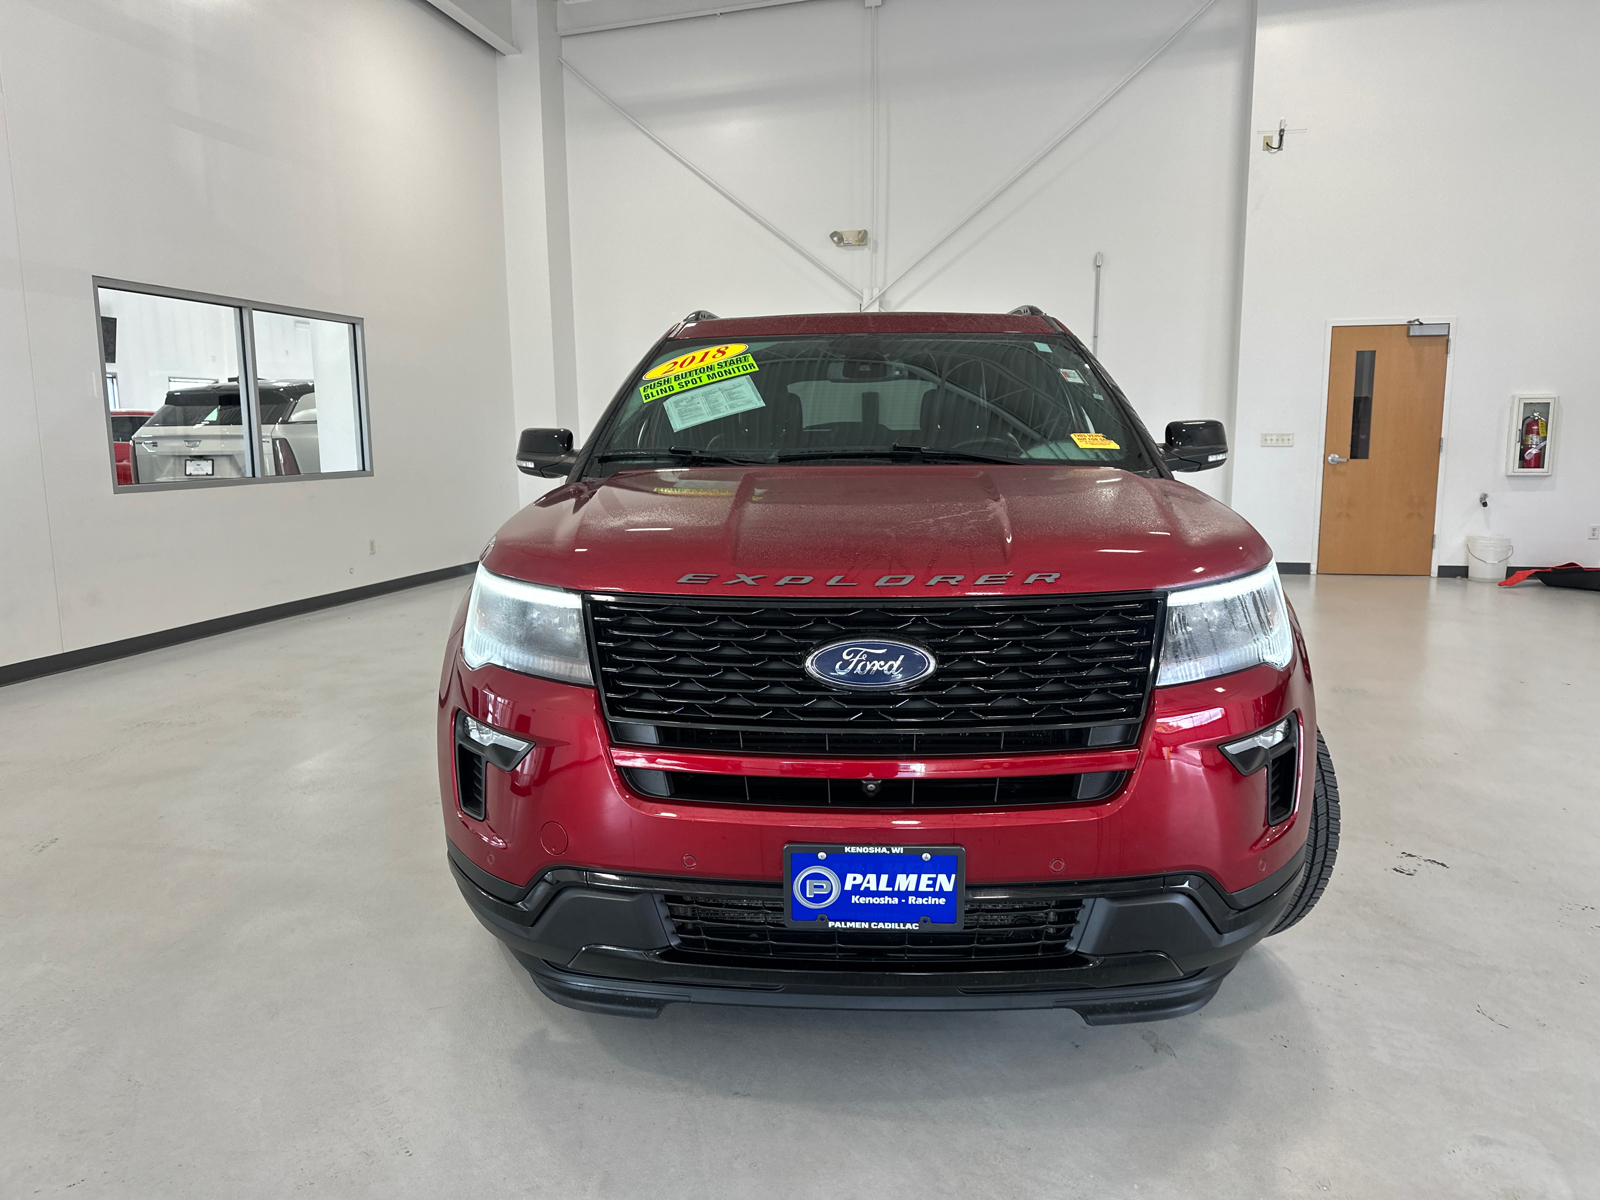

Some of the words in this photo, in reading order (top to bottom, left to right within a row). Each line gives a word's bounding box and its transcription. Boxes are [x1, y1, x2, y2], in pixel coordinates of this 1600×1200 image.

[661, 346, 729, 375] 2018
[642, 377, 671, 393] PUSH
[674, 365, 715, 382] BUTTON
[716, 355, 751, 369] START
[644, 386, 675, 401] BLIND
[678, 376, 703, 389] SPOT
[706, 362, 757, 381] MONITOR
[675, 571, 1062, 588] EXPLORER
[834, 647, 905, 677] Ford
[844, 846, 890, 854] KENOSHA,
[843, 873, 956, 892] PALMEN
[851, 895, 899, 905] Kenosha
[908, 896, 946, 905] Racine
[828, 921, 868, 930] PALMEN
[870, 922, 920, 930] CADILLAC
